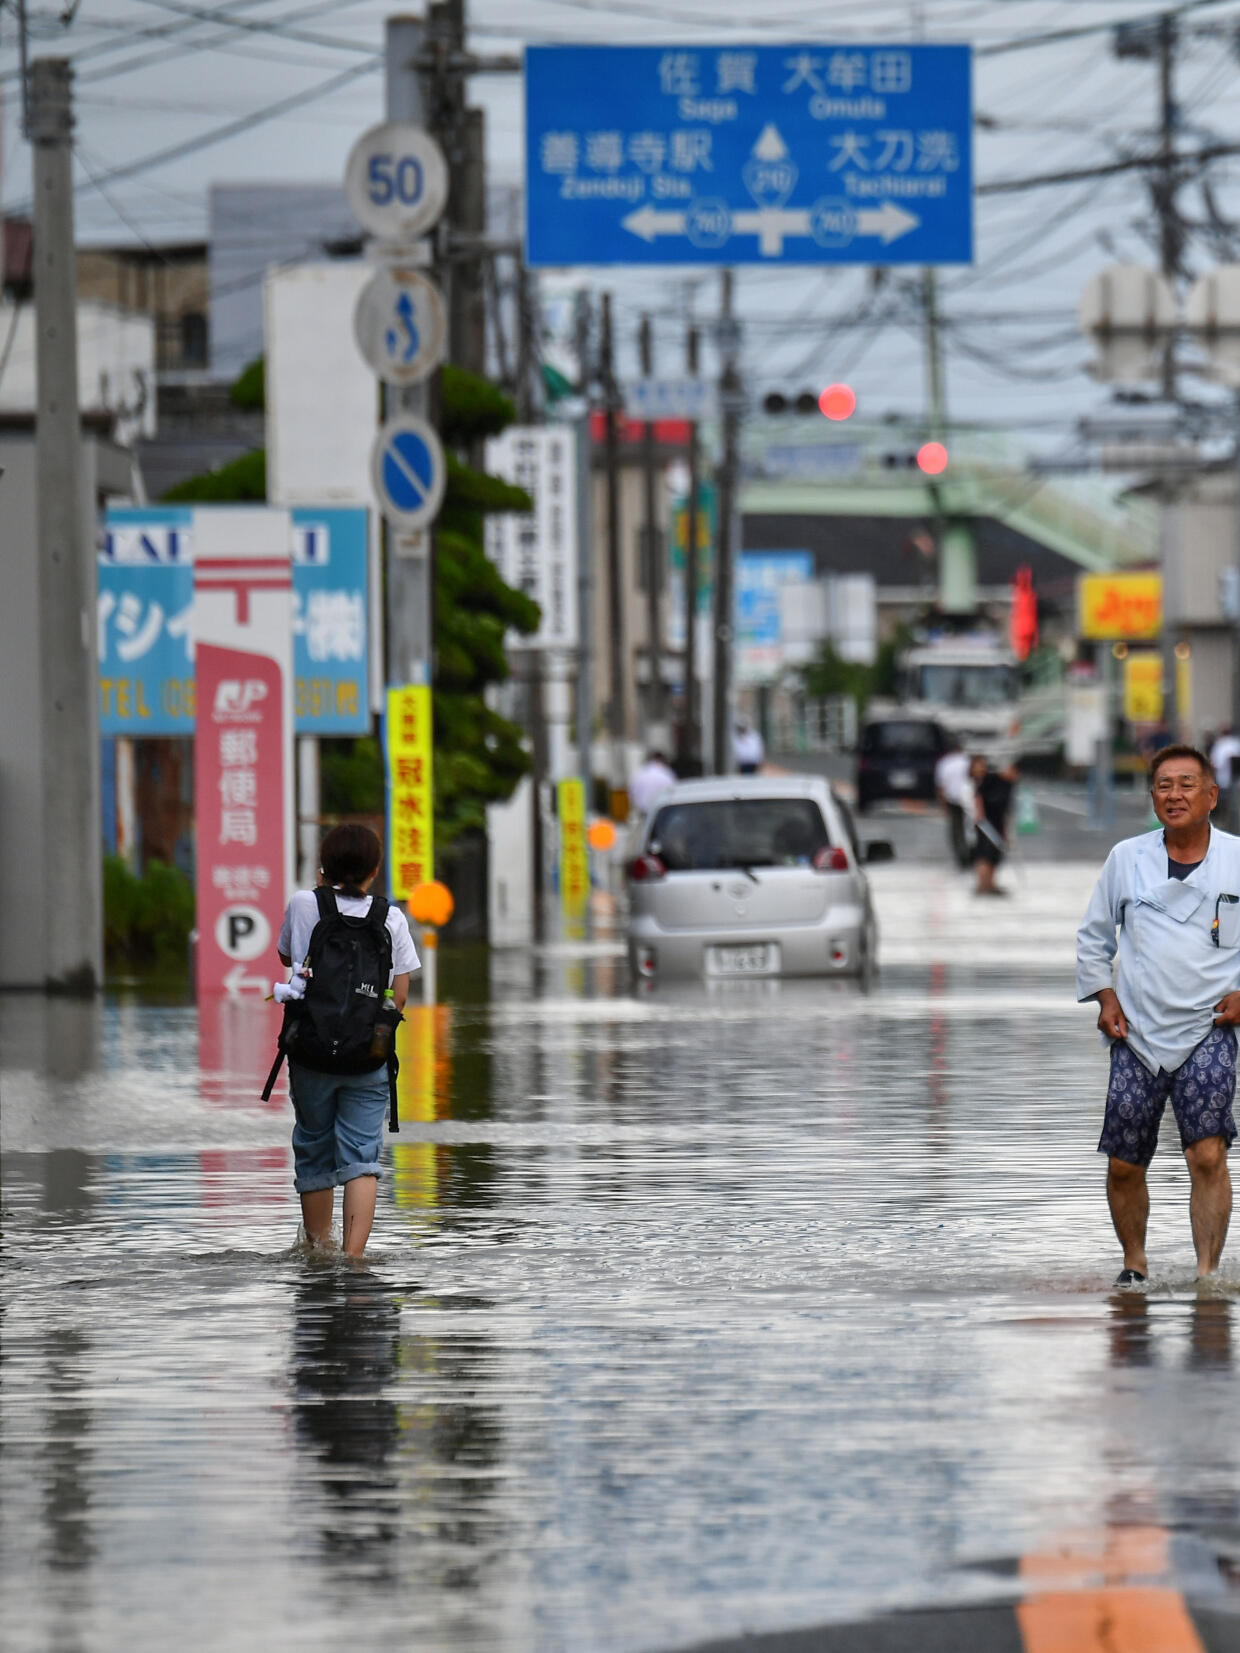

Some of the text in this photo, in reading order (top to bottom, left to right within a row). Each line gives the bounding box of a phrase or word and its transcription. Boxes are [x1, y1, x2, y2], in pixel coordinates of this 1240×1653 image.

[782, 52, 912, 95] 大牟田
[677, 96, 886, 123] Saga Omuta
[541, 129, 959, 174] 善導寺駅 大刀洗
[368, 154, 425, 207] 50
[842, 174, 946, 198] Tachiarai
[100, 676, 151, 718] TEL
[219, 728, 258, 846] 郵便局
[397, 757, 424, 890] 冠水注意
[228, 914, 255, 950] P
